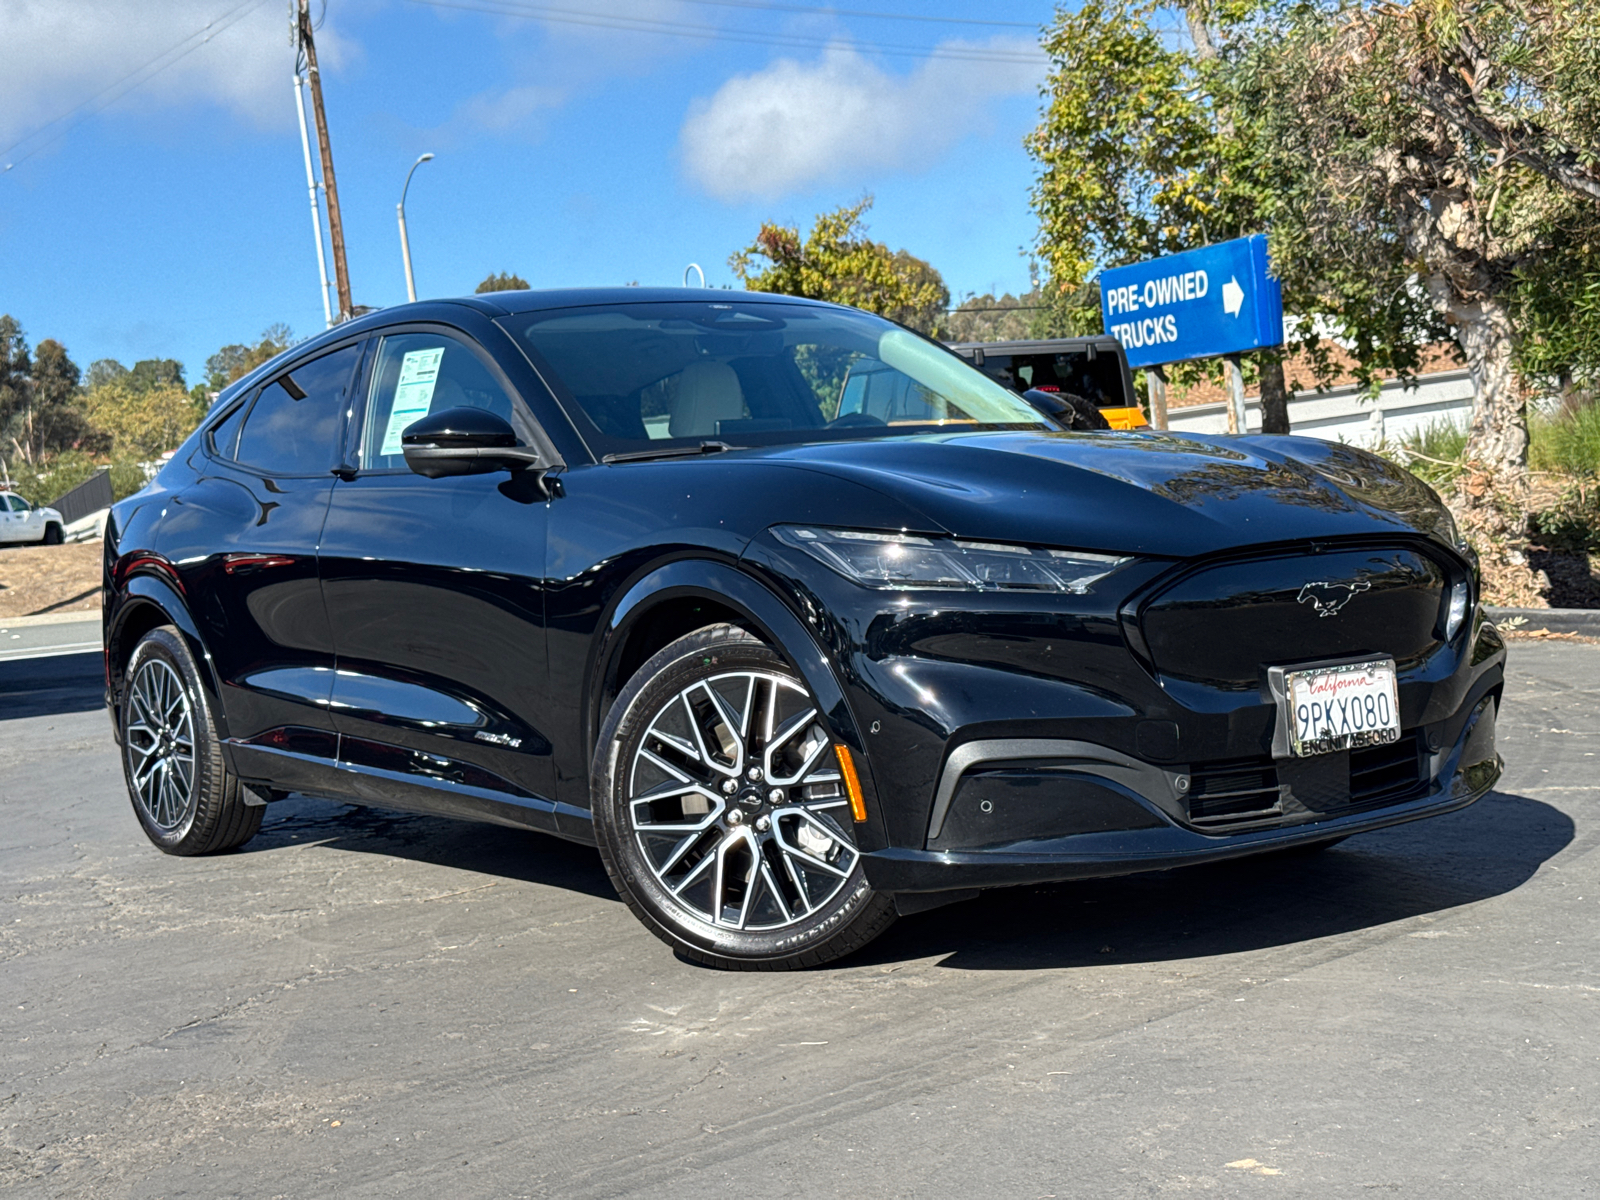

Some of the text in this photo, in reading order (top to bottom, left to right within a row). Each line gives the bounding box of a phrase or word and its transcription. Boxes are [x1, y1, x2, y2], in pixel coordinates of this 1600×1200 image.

[1107, 270, 1208, 315] PRE-OWNED
[1111, 314, 1178, 349] TRUCKS
[1309, 673, 1374, 696] California
[1297, 692, 1390, 740] 9PKX080
[1366, 728, 1396, 745] FORD
